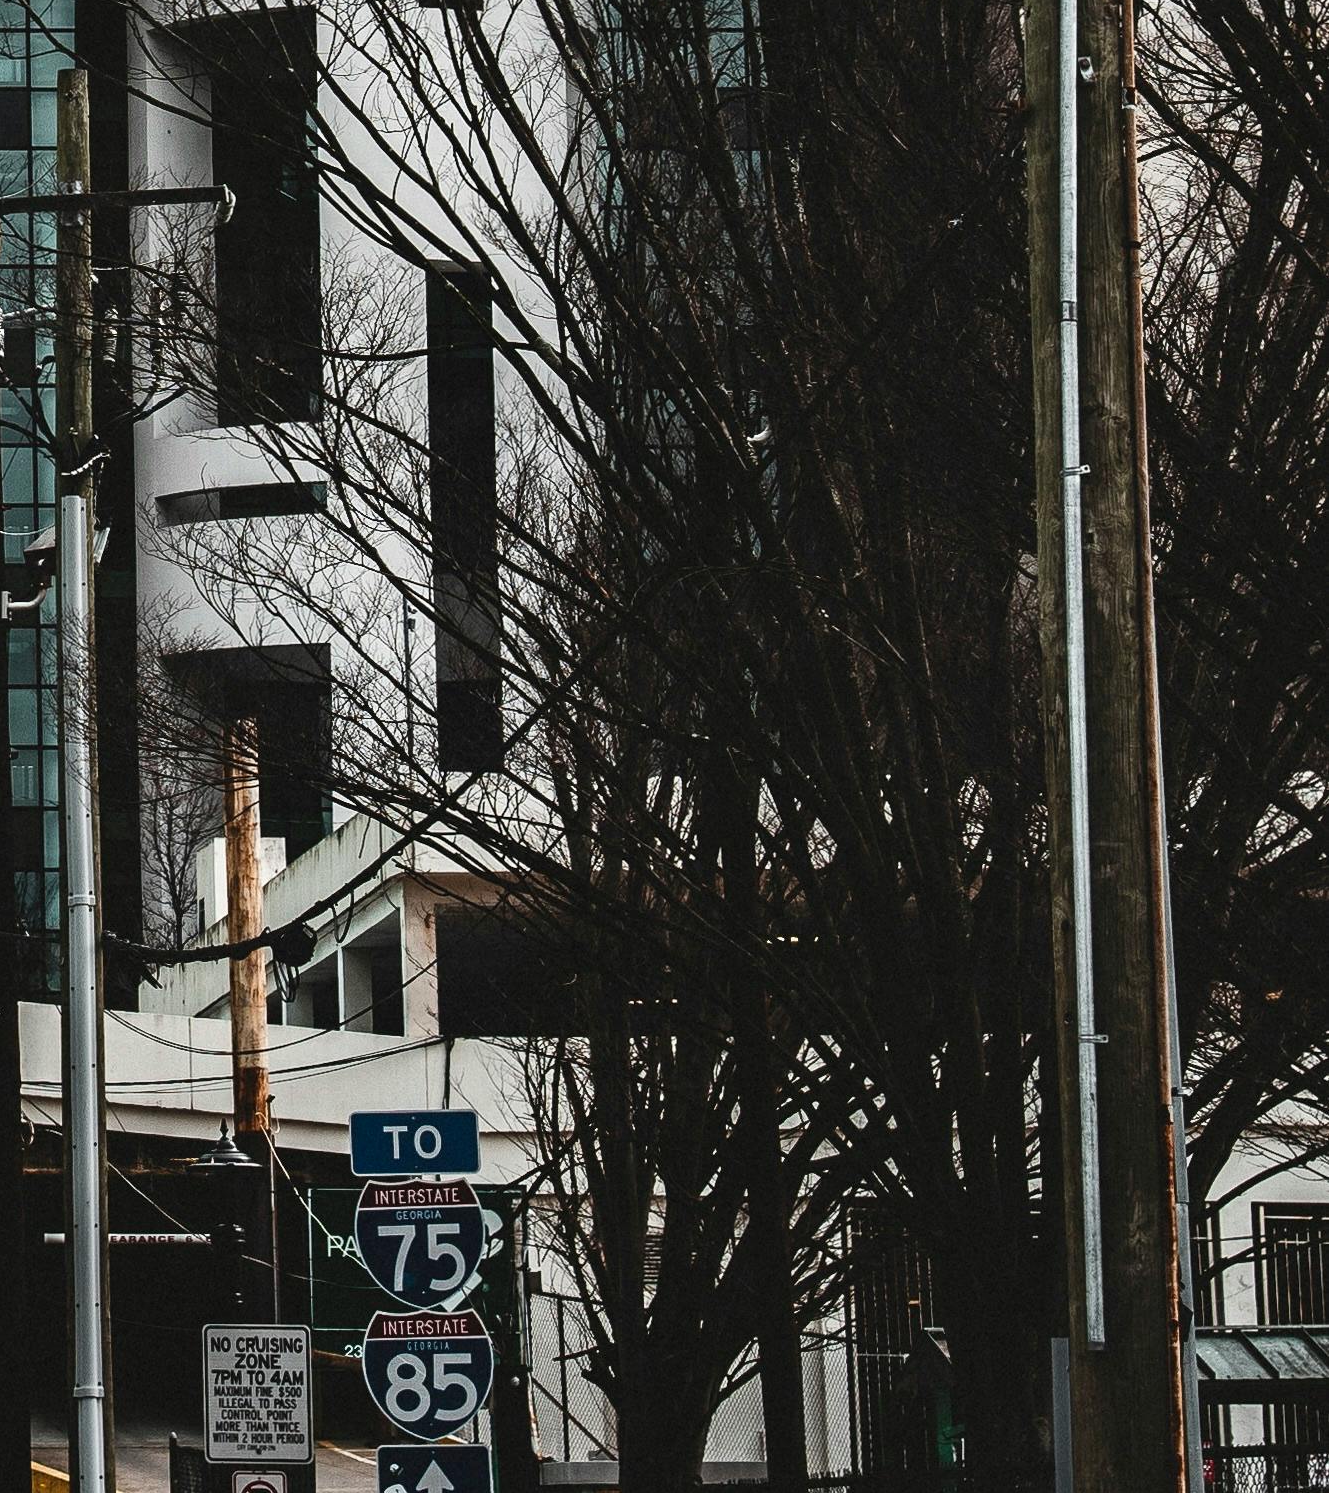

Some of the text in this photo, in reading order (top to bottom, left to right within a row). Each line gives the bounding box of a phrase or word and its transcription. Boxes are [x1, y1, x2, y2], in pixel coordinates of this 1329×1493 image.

[383, 1125, 442, 1160] TO
[374, 1188, 460, 1205] INTERSTATE
[396, 1210, 442, 1220] GEORGIA
[377, 1223, 466, 1292] 75
[383, 1318, 469, 1335] INTERSTATE
[210, 1336, 303, 1354] NO CRUISING
[407, 1341, 450, 1351] GEORGIA
[234, 1353, 282, 1369] ZONE
[212, 1369, 304, 1386] 7PM TO 4AM
[214, 1386, 302, 1398] MAXIMUM FINE $500
[386, 1353, 478, 1422] 85
[219, 1398, 297, 1409] ILLEGAL TO PASS
[222, 1409, 293, 1421] CONTROL POINT
[215, 1421, 300, 1433] MORE THAN TWICE
[213, 1433, 305, 1444] WITHIN 2 HOUR PERIOD
